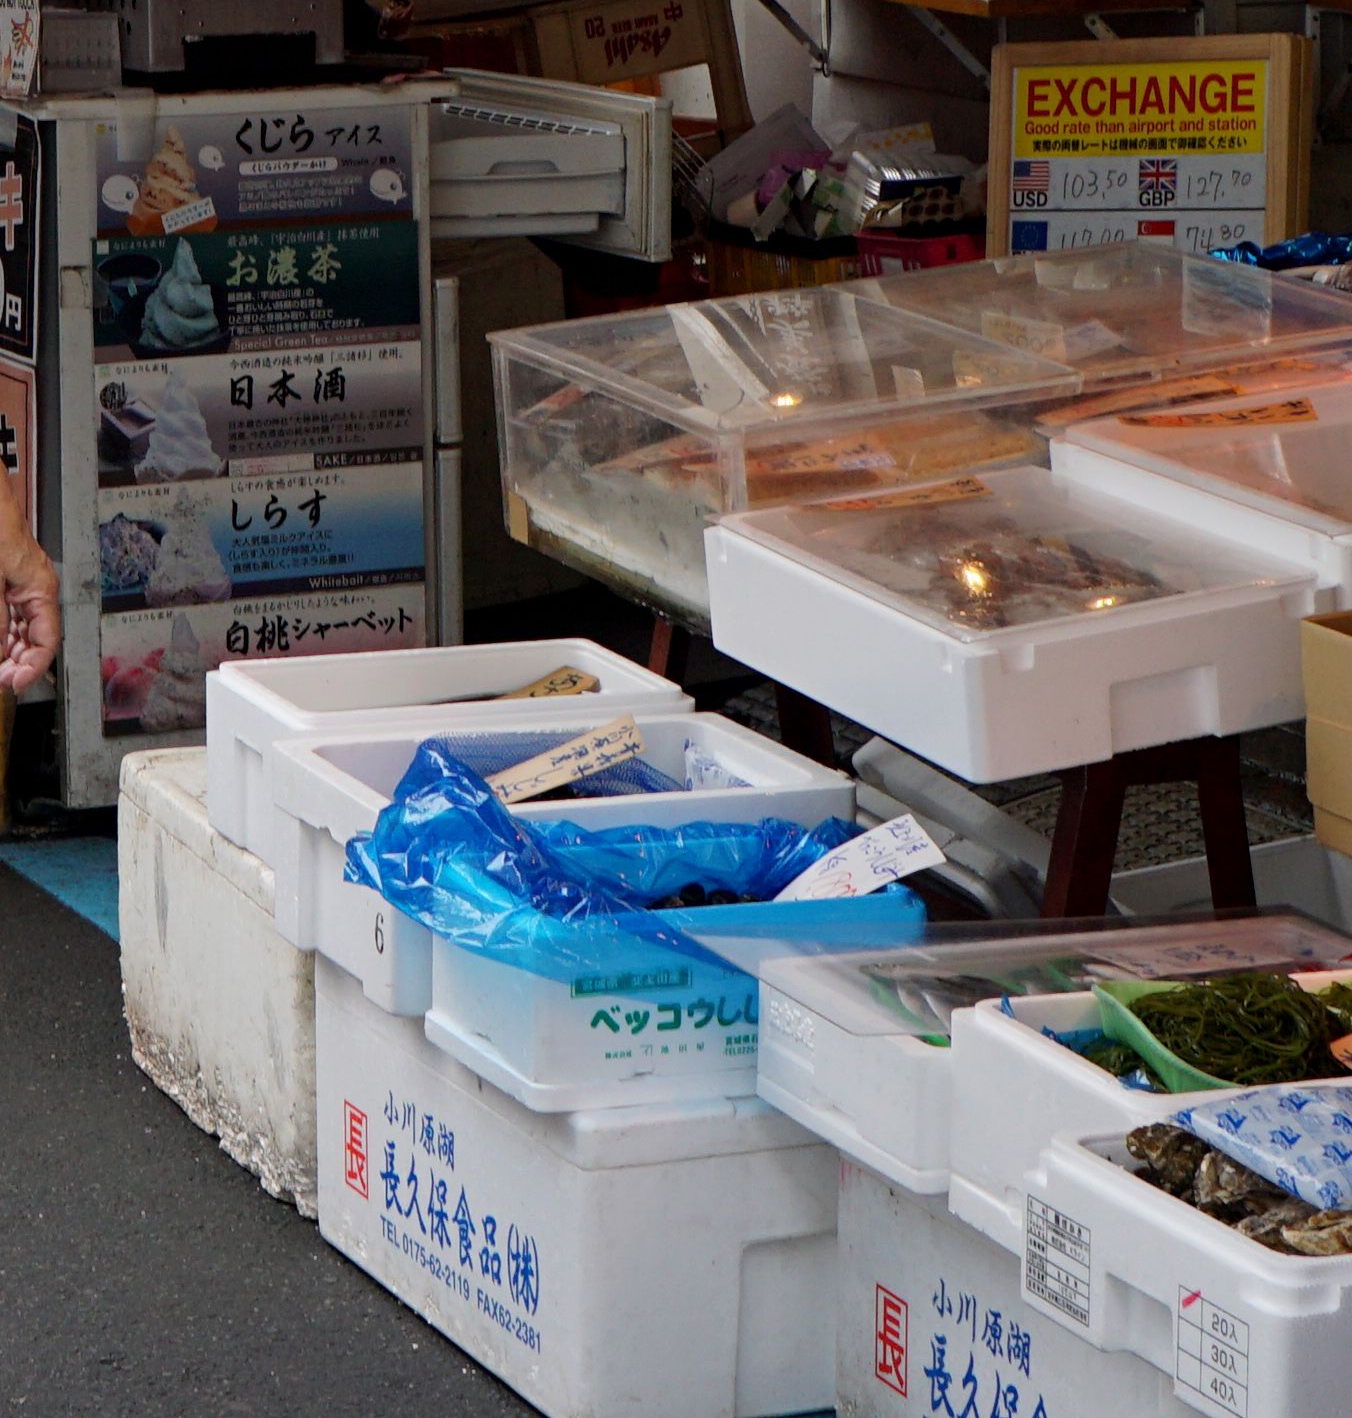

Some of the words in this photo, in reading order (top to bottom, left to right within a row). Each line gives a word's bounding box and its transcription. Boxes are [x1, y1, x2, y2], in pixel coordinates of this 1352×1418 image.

[584, 15, 607, 40] 20
[604, 26, 673, 68] Asahi
[1026, 72, 1256, 119] EXCHANGE
[235, 114, 315, 154] くじら
[324, 124, 384, 147] アイス
[1025, 120, 1060, 135] Good
[1063, 120, 1091, 135] rate
[1095, 119, 1125, 134] than
[1128, 118, 1176, 136] airport
[1179, 118, 1204, 132] and
[1208, 117, 1257, 131] station
[1012, 190, 1048, 208] USD
[1138, 189, 1176, 208] GBP
[225, 242, 343, 287] お濃茶
[234, 338, 273, 351] Special
[274, 335, 308, 349] Green
[310, 334, 329, 346] Tea
[229, 366, 347, 410] 日本酒
[314, 454, 346, 468] SAKE
[230, 487, 328, 532] しらす
[308, 575, 364, 589] Whitebait
[225, 606, 414, 655] 白桃シャーベット
[374, 911, 385, 956] 6
[346, 1110, 367, 1191] 長
[383, 1089, 455, 1172] 小川原湖
[379, 1140, 540, 1317] 長久保食品(株)
[379, 1214, 400, 1250] TEL
[402, 1233, 471, 1302] 0175-62-2119
[476, 1286, 542, 1355] FAX62-2381
[877, 1296, 905, 1389] 長
[932, 1277, 1032, 1380] 小川原湖
